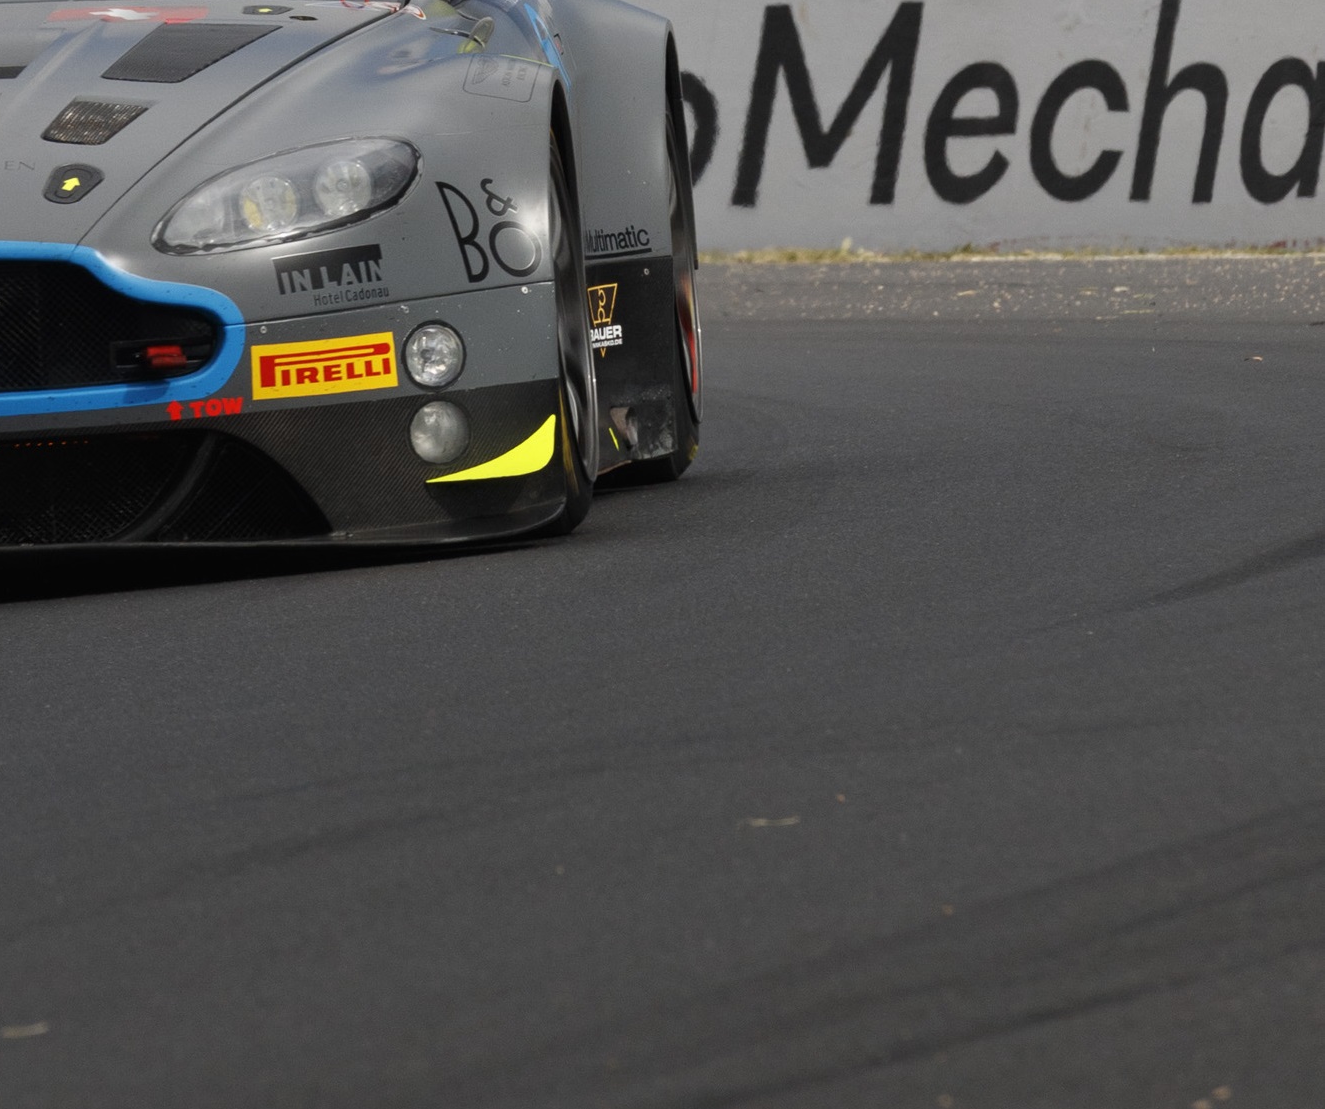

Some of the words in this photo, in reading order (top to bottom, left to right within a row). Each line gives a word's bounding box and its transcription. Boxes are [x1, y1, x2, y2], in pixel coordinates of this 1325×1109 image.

[314, 292, 344, 307] Hotel
[345, 286, 390, 302] Cadonau
[259, 342, 391, 388] PIRELLI
[189, 397, 244, 418] TOW
